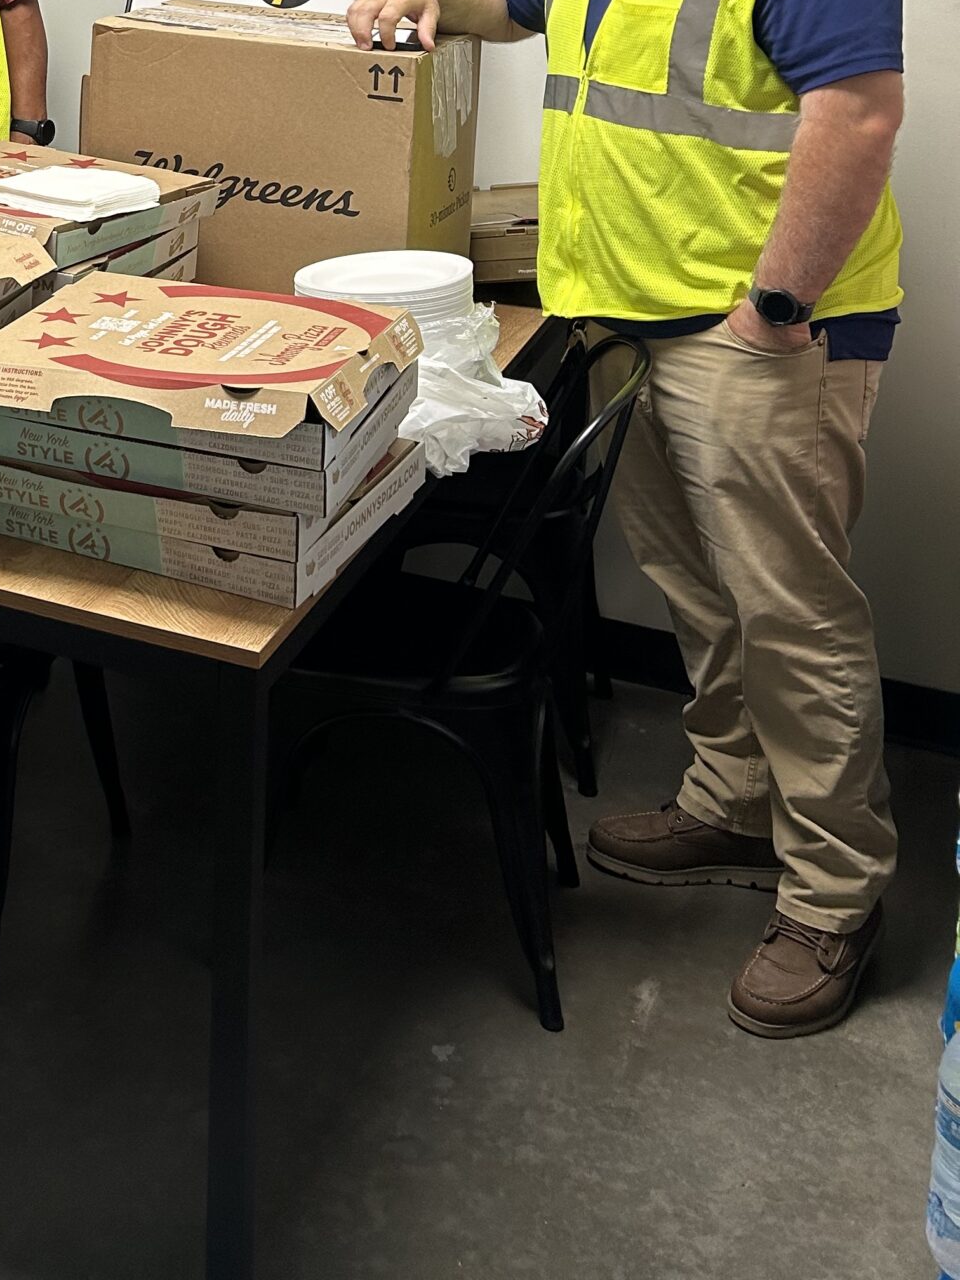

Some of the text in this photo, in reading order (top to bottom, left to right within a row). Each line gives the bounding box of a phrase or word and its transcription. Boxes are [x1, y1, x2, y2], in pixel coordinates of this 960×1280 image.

[134, 150, 360, 217] Wlgreens
[16, 222, 36, 234] OFF
[136, 309, 208, 353] JOHNNY'S
[157, 312, 242, 357] DOUGH
[201, 324, 252, 350] Rewards
[281, 324, 330, 342] Pizza
[204, 397, 277, 415] MADE FRESH
[220, 409, 255, 428] daily
[20, 426, 71, 448] New York
[17, 441, 75, 465] STYLE
[20, 477, 44, 492] York
[213, 487, 249, 499] CALZONES
[263, 485, 286, 495] PASTA
[290, 490, 310, 498] PIZZA
[344, 458, 420, 542] JOHNNYSPIZZA.COM
[8, 504, 56, 527] New York
[6, 518, 59, 545] STYLE
